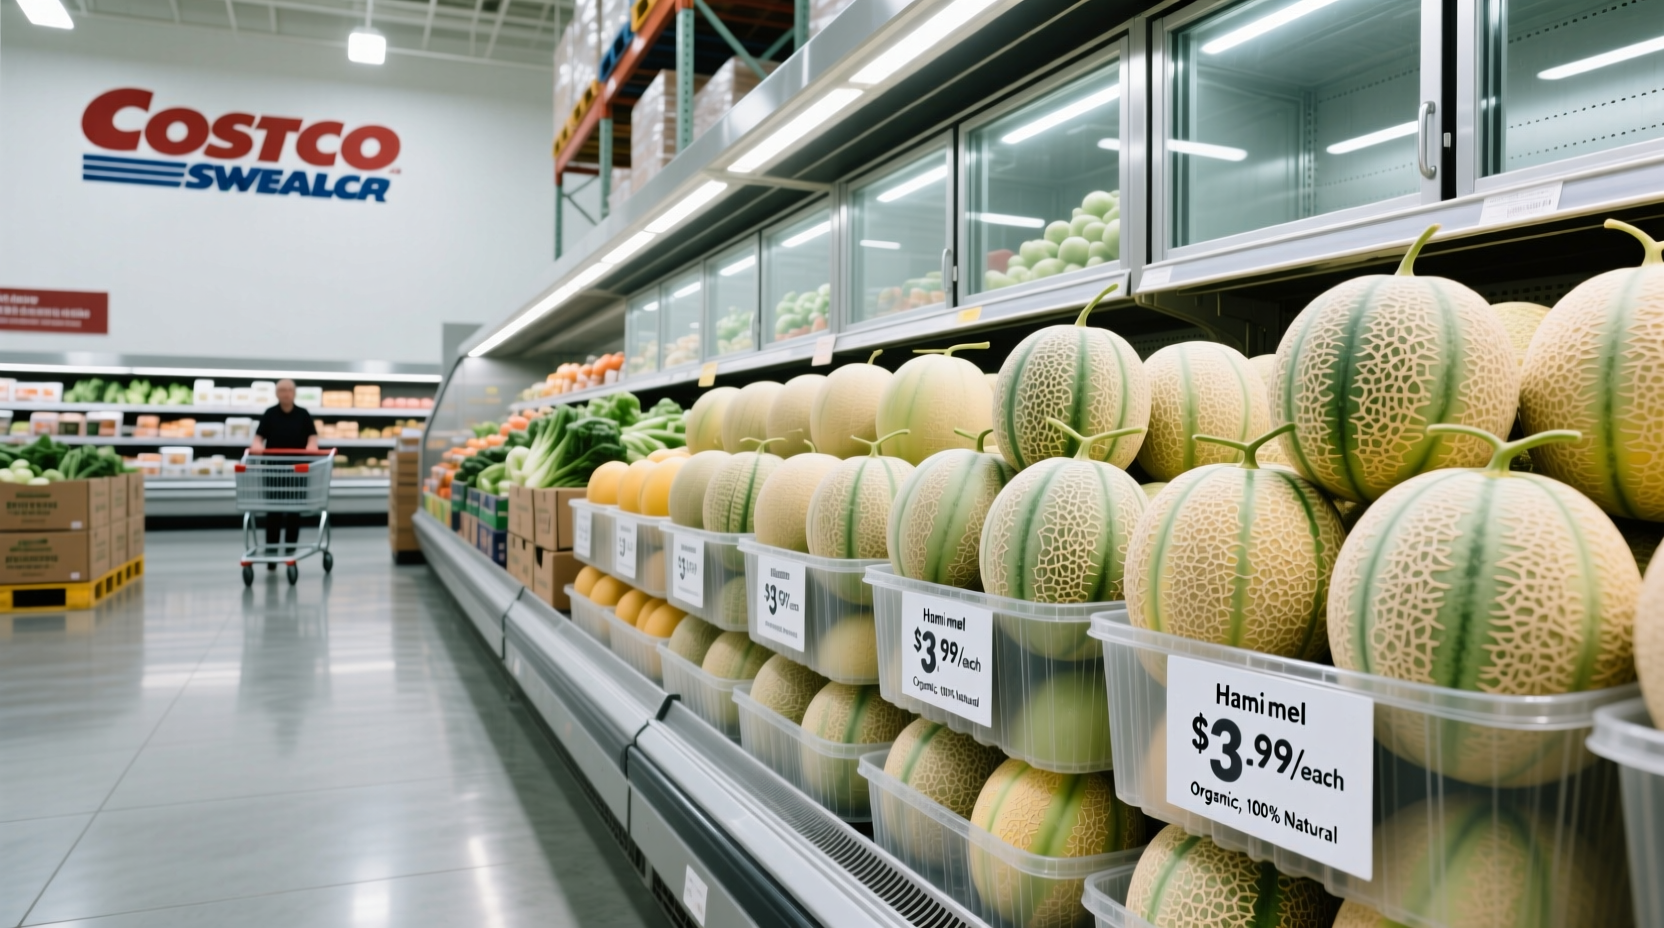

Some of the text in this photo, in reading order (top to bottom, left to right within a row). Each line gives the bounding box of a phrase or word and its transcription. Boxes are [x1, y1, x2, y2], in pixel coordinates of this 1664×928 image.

[1191, 712, 1344, 791] $3.99/each
[1190, 780, 1338, 844] Organic, 100% Natural
